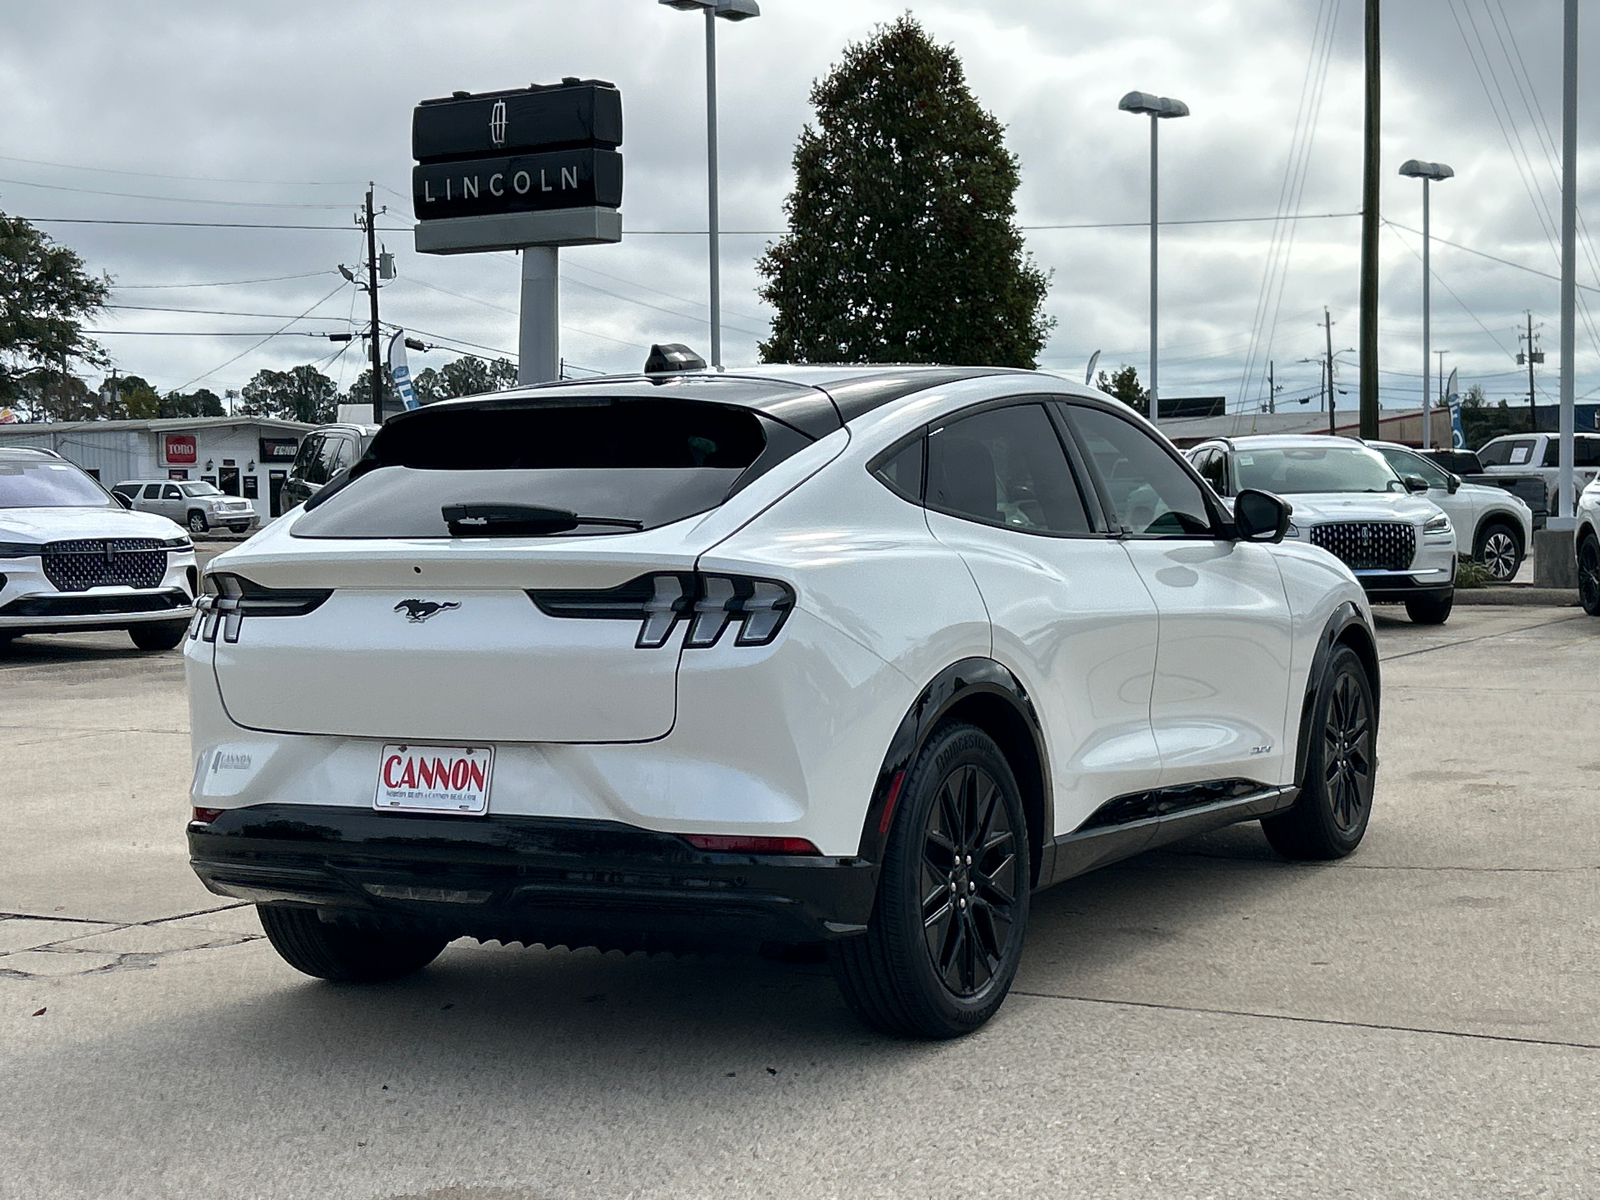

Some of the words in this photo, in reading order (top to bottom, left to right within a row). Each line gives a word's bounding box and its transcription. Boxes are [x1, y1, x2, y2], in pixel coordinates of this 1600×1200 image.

[424, 166, 578, 203] LINCOLN
[168, 443, 194, 455] TORO
[273, 445, 298, 456] ECHO
[935, 734, 995, 774] BRIDGESTONE
[383, 754, 487, 792] CANNON
